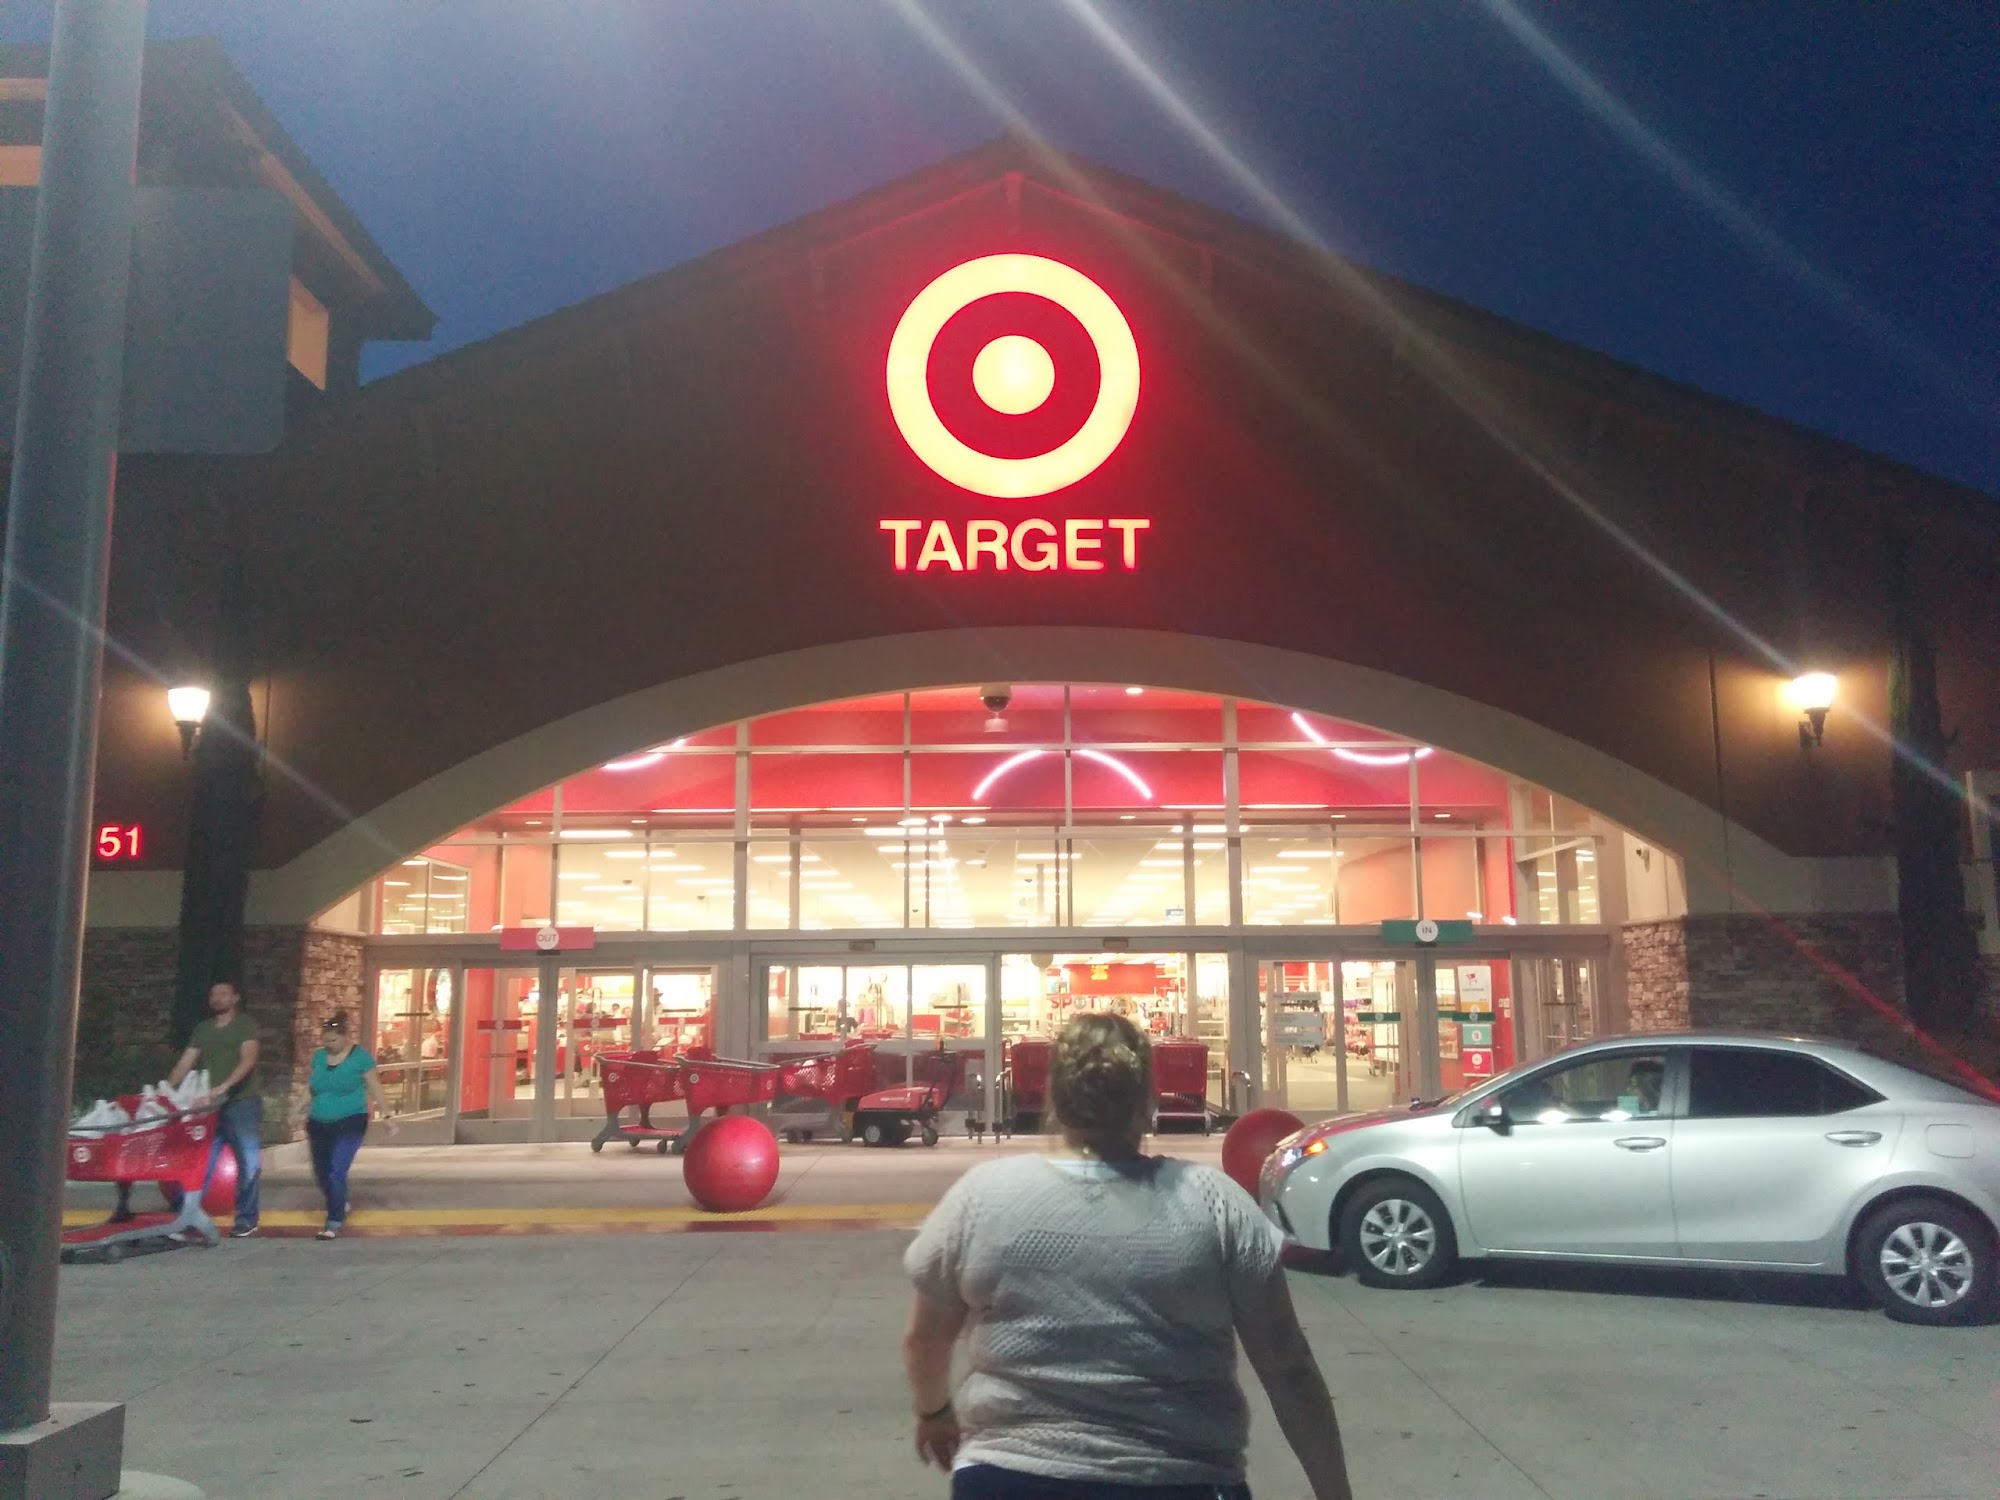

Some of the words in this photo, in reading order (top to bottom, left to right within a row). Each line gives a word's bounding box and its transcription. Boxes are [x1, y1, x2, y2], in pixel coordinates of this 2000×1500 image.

[879, 518, 1151, 572] TARGET
[99, 826, 139, 857] 51
[538, 934, 557, 942] OUT
[1422, 926, 1432, 934] IN
